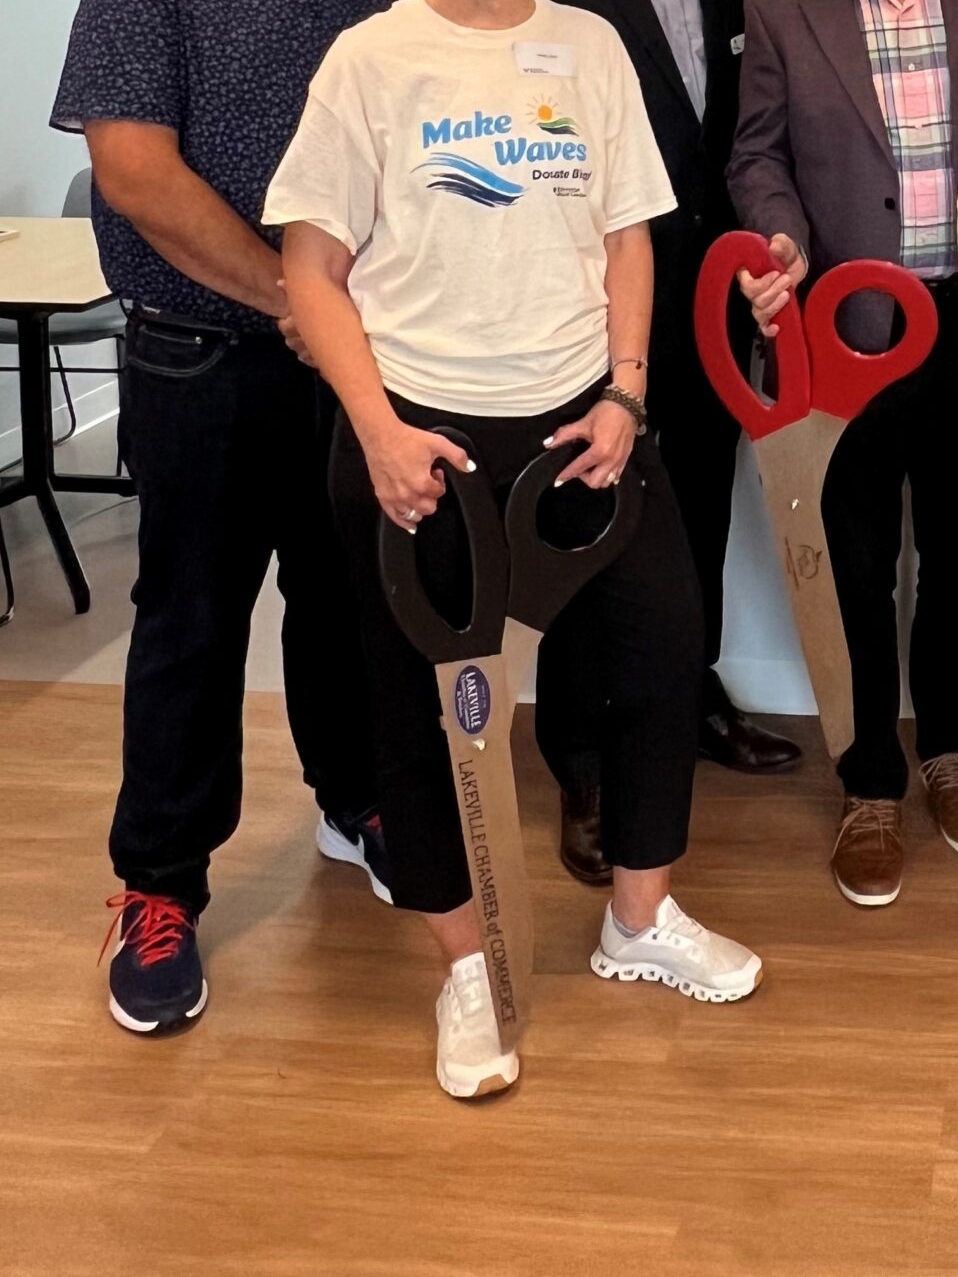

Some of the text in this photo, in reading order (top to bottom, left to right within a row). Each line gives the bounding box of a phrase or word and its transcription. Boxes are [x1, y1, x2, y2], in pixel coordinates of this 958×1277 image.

[422, 110, 513, 149] Make
[494, 137, 588, 167] Waves
[465, 671, 482, 728] LAKEVILLE
[458, 759, 517, 1026] LAKEVILLE CHAMBER of COMMERCE
